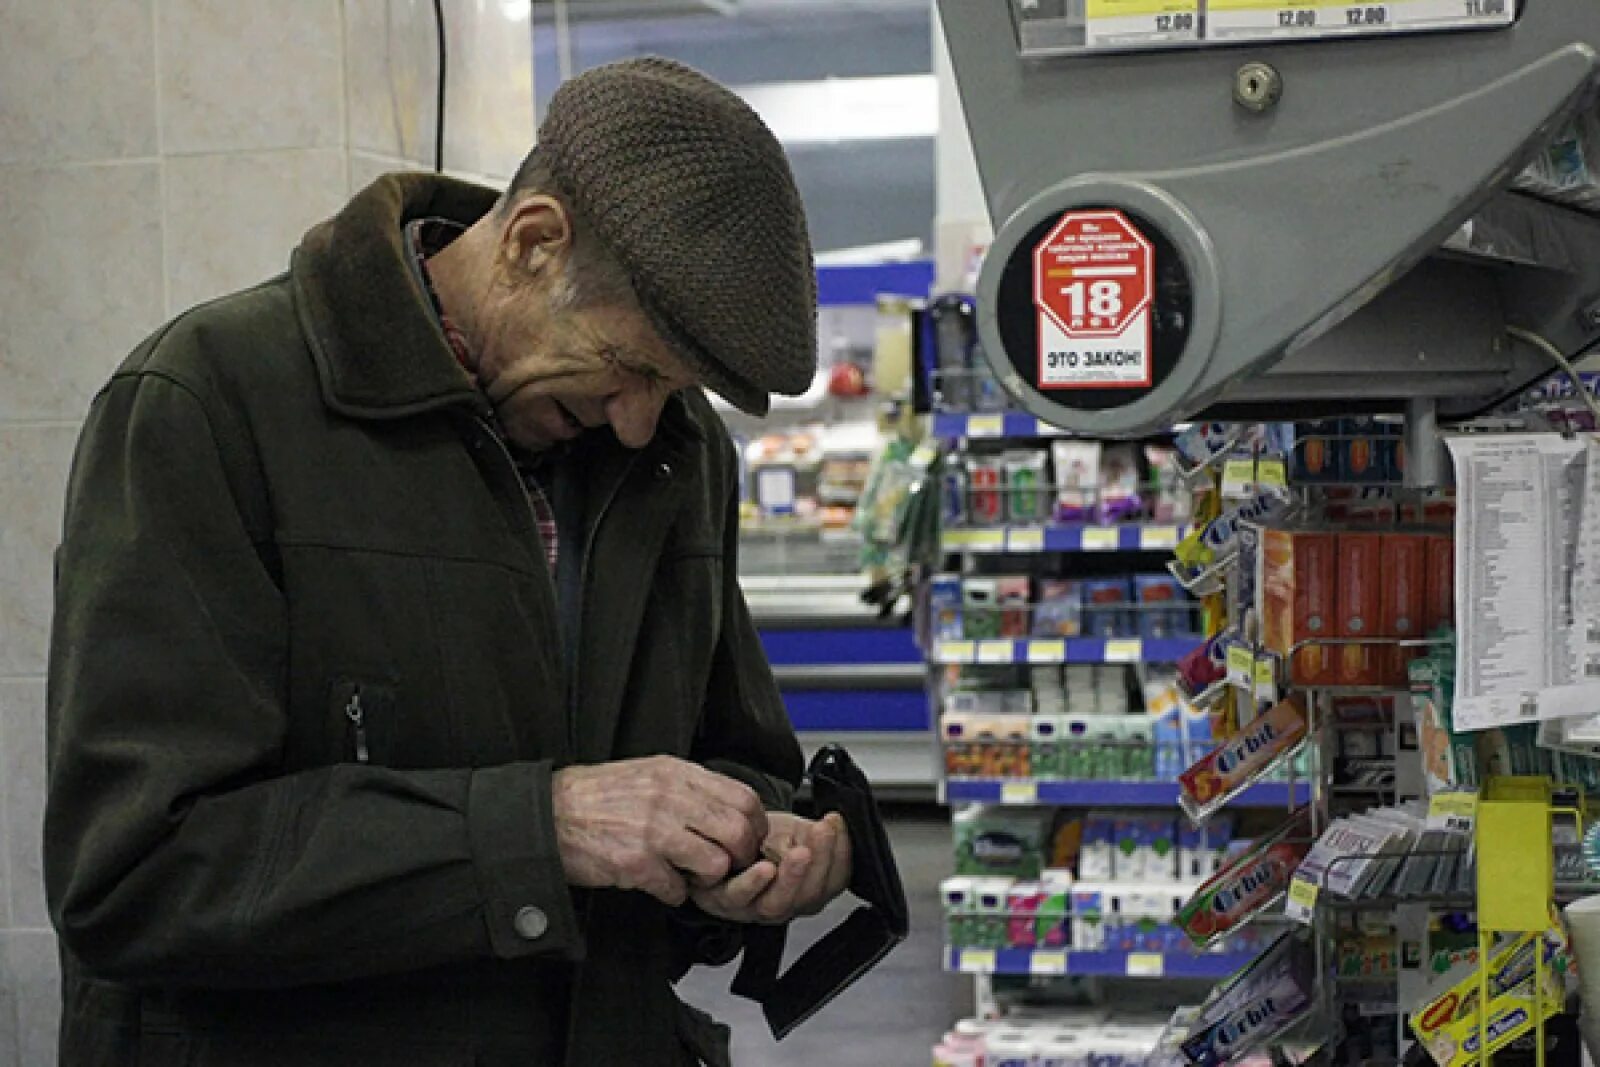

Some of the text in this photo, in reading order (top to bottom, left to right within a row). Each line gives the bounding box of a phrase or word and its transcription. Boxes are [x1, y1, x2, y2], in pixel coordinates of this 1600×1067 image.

[1059, 281, 1122, 317] 18
[1047, 351, 1080, 369] ЭТО
[1216, 722, 1275, 774] Orbit
[1212, 862, 1273, 913] Orbit
[1217, 996, 1276, 1044] Orbit
